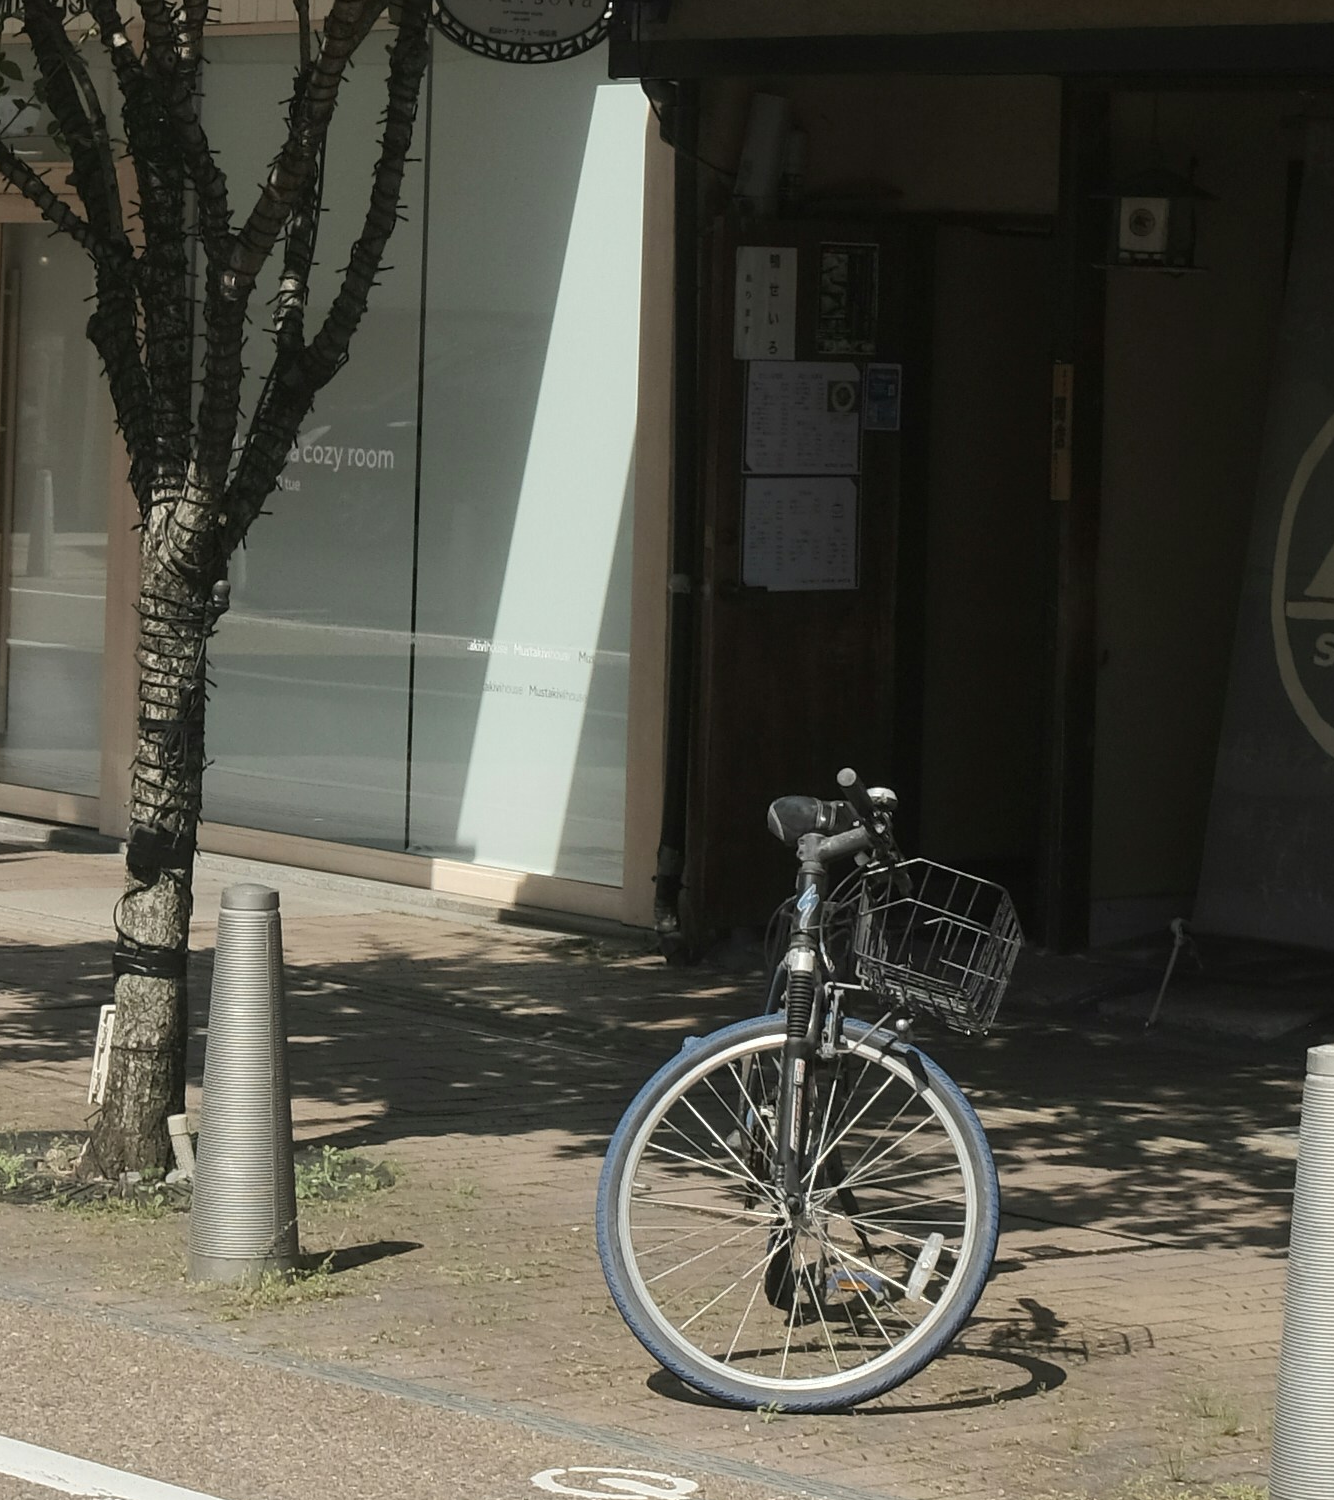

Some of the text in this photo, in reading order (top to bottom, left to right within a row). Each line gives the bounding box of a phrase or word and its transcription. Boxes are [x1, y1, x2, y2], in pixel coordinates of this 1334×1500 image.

[302, 445, 345, 472] cozy
[347, 447, 395, 469] room
[284, 477, 301, 492] tue
